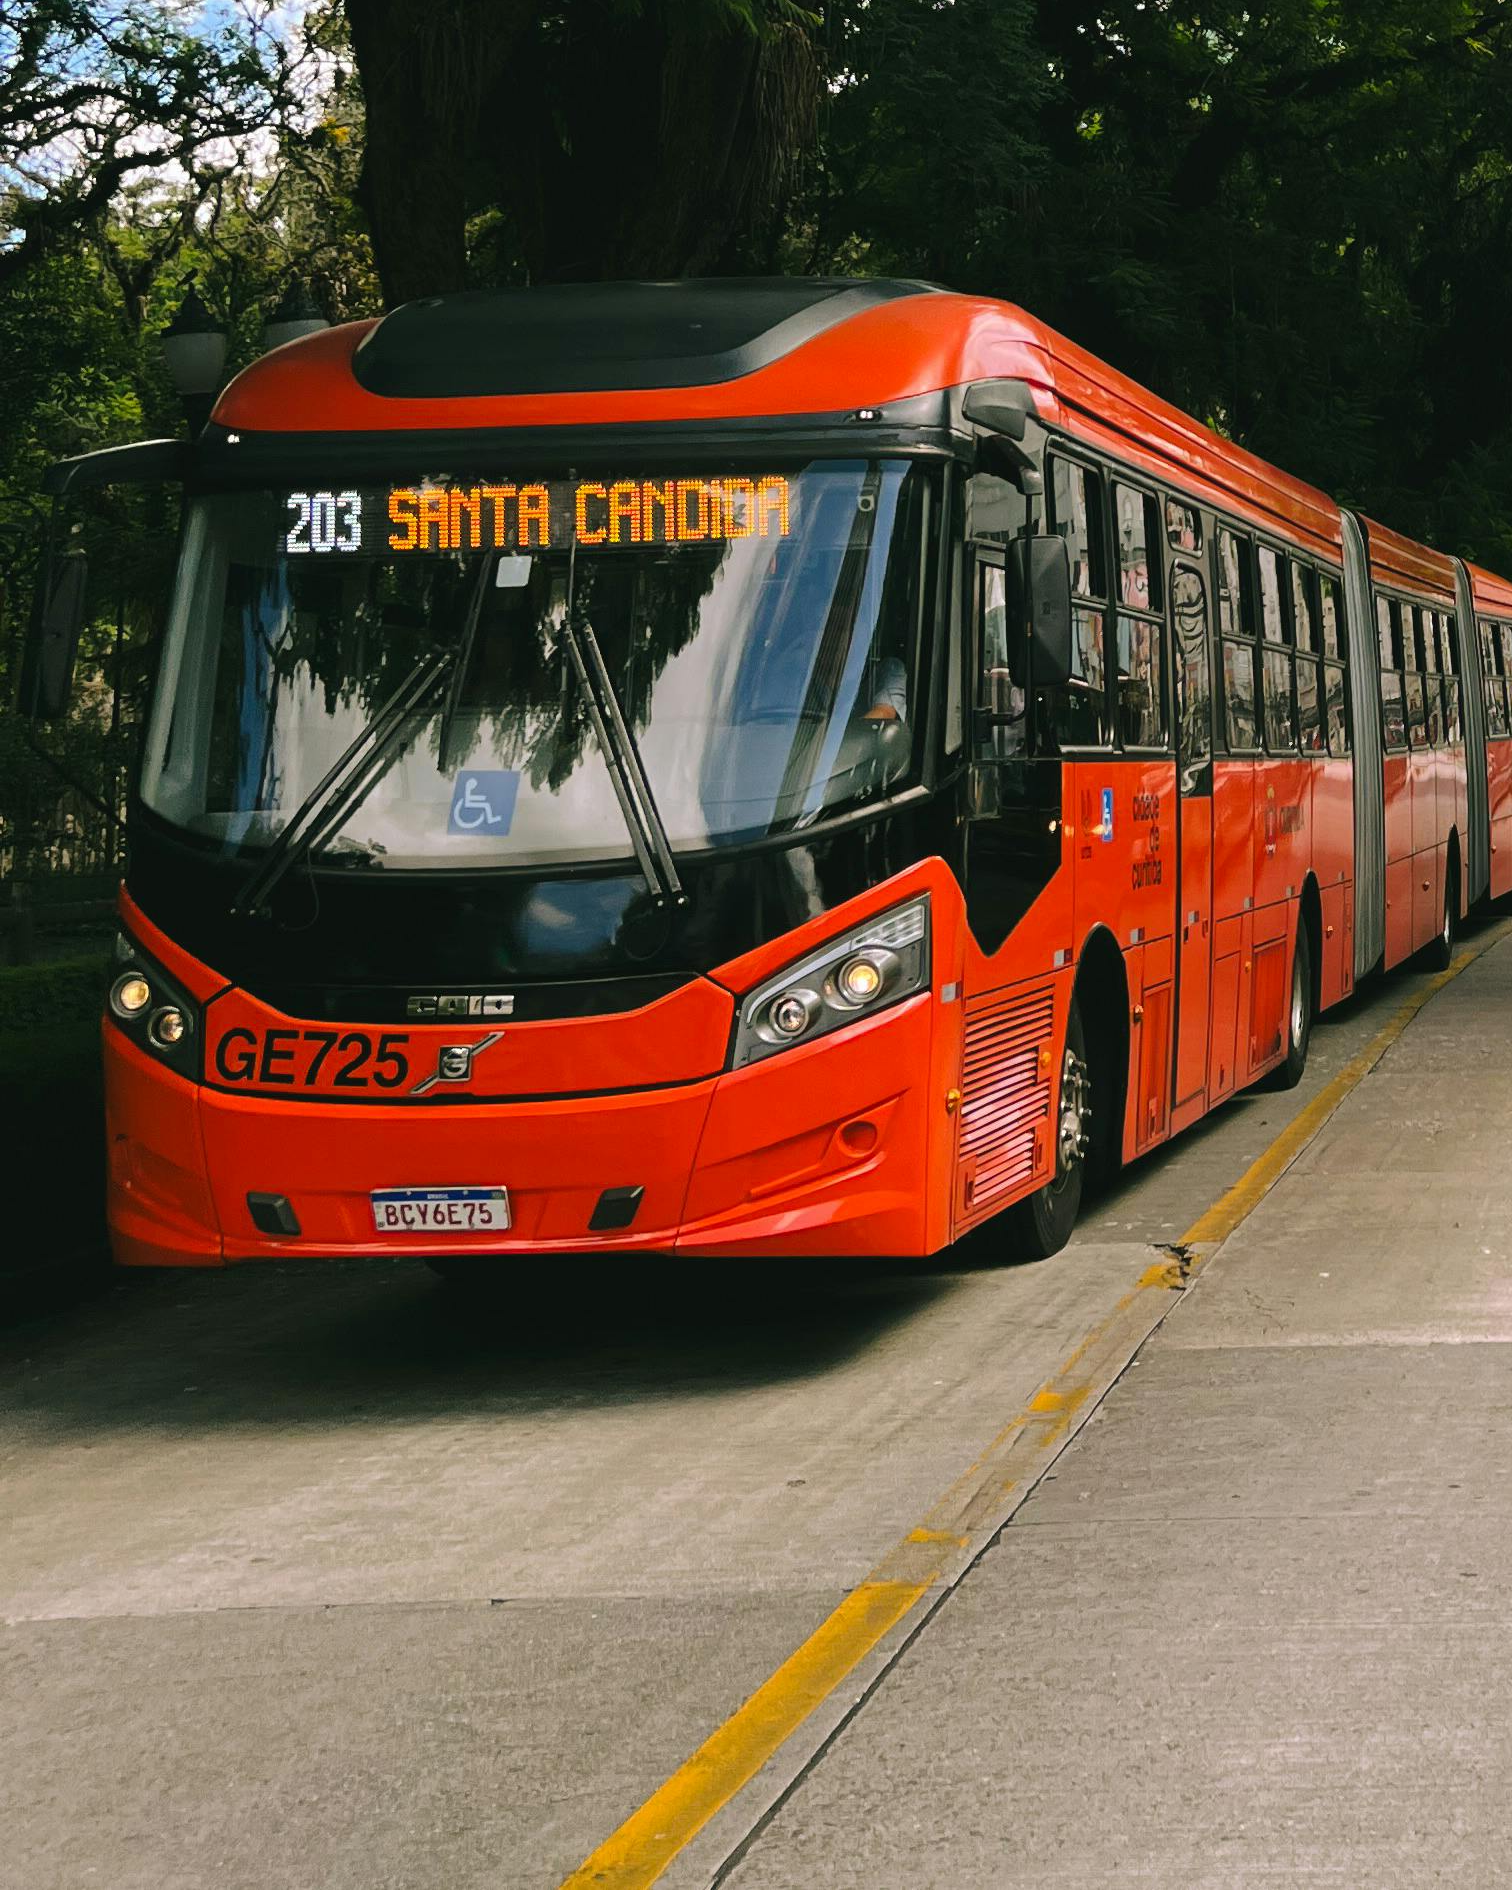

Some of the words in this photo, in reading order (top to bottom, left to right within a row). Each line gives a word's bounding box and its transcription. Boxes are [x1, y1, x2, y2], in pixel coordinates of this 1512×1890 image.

[286, 491, 362, 552] 203
[388, 483, 550, 550] SANTA
[575, 476, 790, 543] CANDIDA
[407, 995, 515, 1015] CAIO
[215, 1028, 410, 1089] GE725
[384, 1203, 494, 1227] BCY6E75
